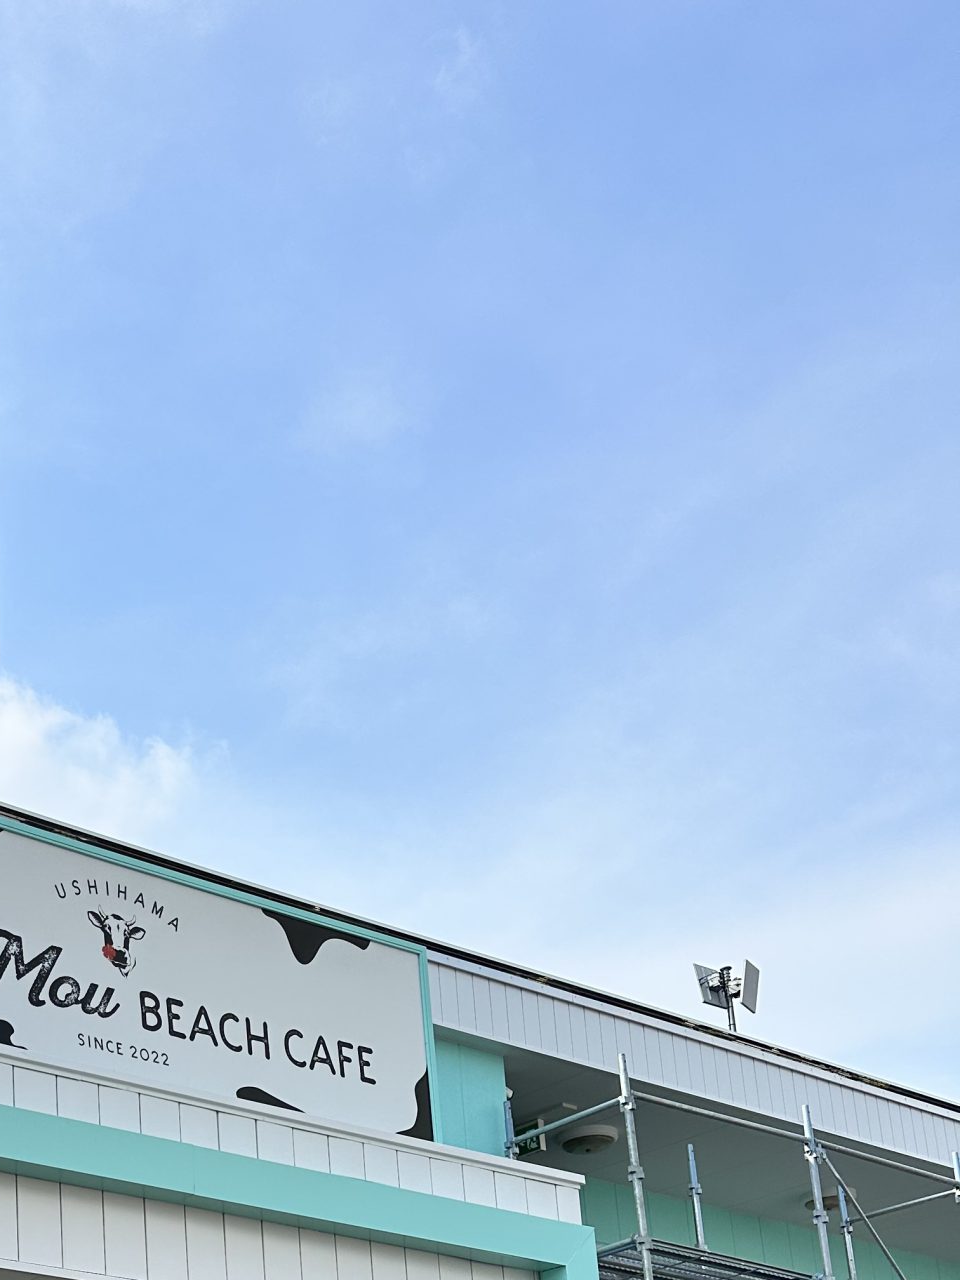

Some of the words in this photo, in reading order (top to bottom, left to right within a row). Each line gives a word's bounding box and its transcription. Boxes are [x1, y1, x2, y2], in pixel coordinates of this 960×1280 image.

[54, 879, 180, 932] USHIHAMA
[77, 1033, 123, 1056] SINCE
[129, 1045, 170, 1066] 2022
[139, 990, 270, 1060] BEACH
[284, 1029, 377, 1086] CAFE
